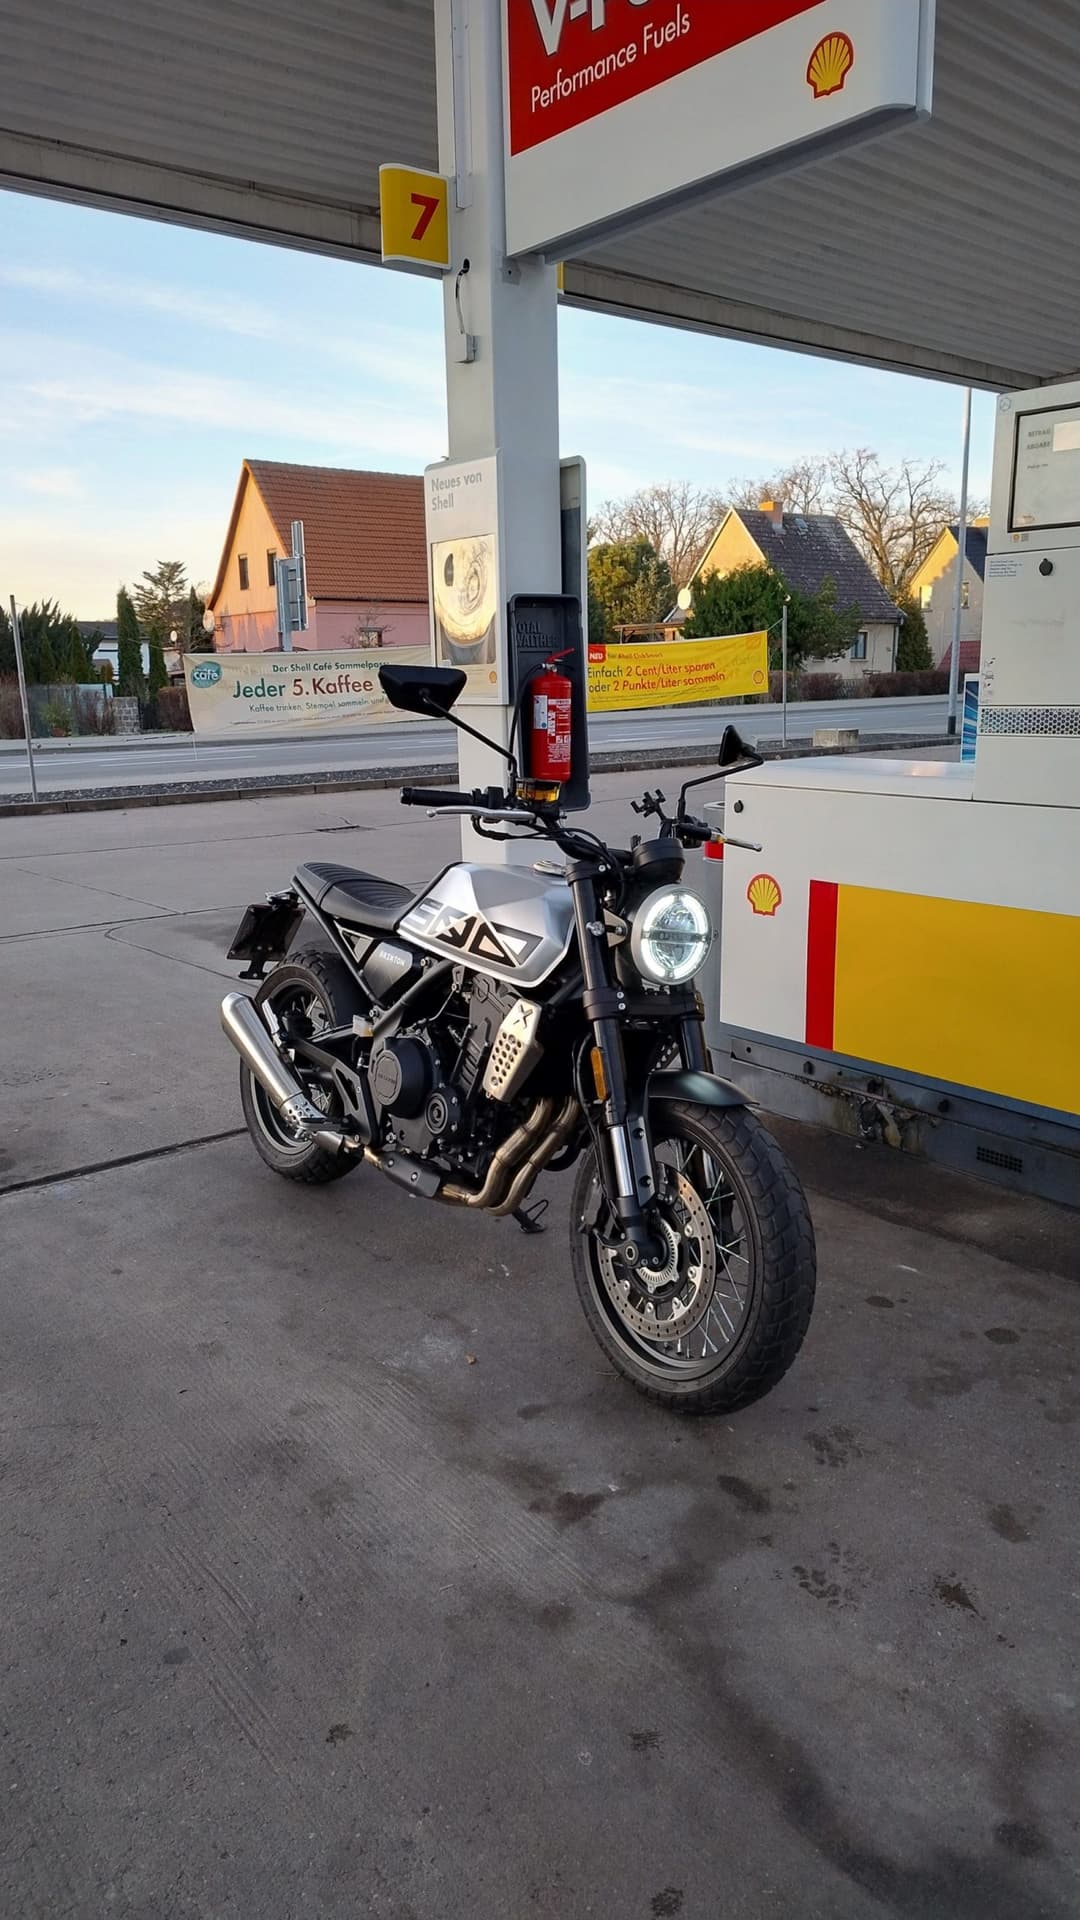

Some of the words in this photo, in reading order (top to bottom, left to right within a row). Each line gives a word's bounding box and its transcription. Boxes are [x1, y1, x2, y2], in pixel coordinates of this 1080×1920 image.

[531, 42, 637, 113] Performance
[643, 3, 690, 55] Fuels
[410, 191, 441, 241] 7
[431, 476, 461, 492] Neues
[463, 472, 482, 485] von
[431, 492, 454, 511] Shell
[515, 620, 542, 635] OTAL
[272, 664, 288, 673] Der
[290, 663, 312, 672] Shell
[313, 662, 332, 671] Café
[588, 665, 623, 678] Einfach
[626, 666, 633, 677] 2
[636, 663, 682, 677] Cent/Liter
[684, 661, 716, 675] sparen
[233, 677, 286, 698] Jeder
[292, 678, 310, 696] 5.
[312, 674, 374, 695] Kaffee
[589, 680, 611, 693] oder
[613, 680, 620, 691] 2
[622, 677, 681, 691] Punkte/Liter
[683, 671, 726, 686] sammeln
[249, 703, 275, 713] Kaffee
[305, 700, 336, 710] Stempel
[337, 698, 369, 708] sammeln
